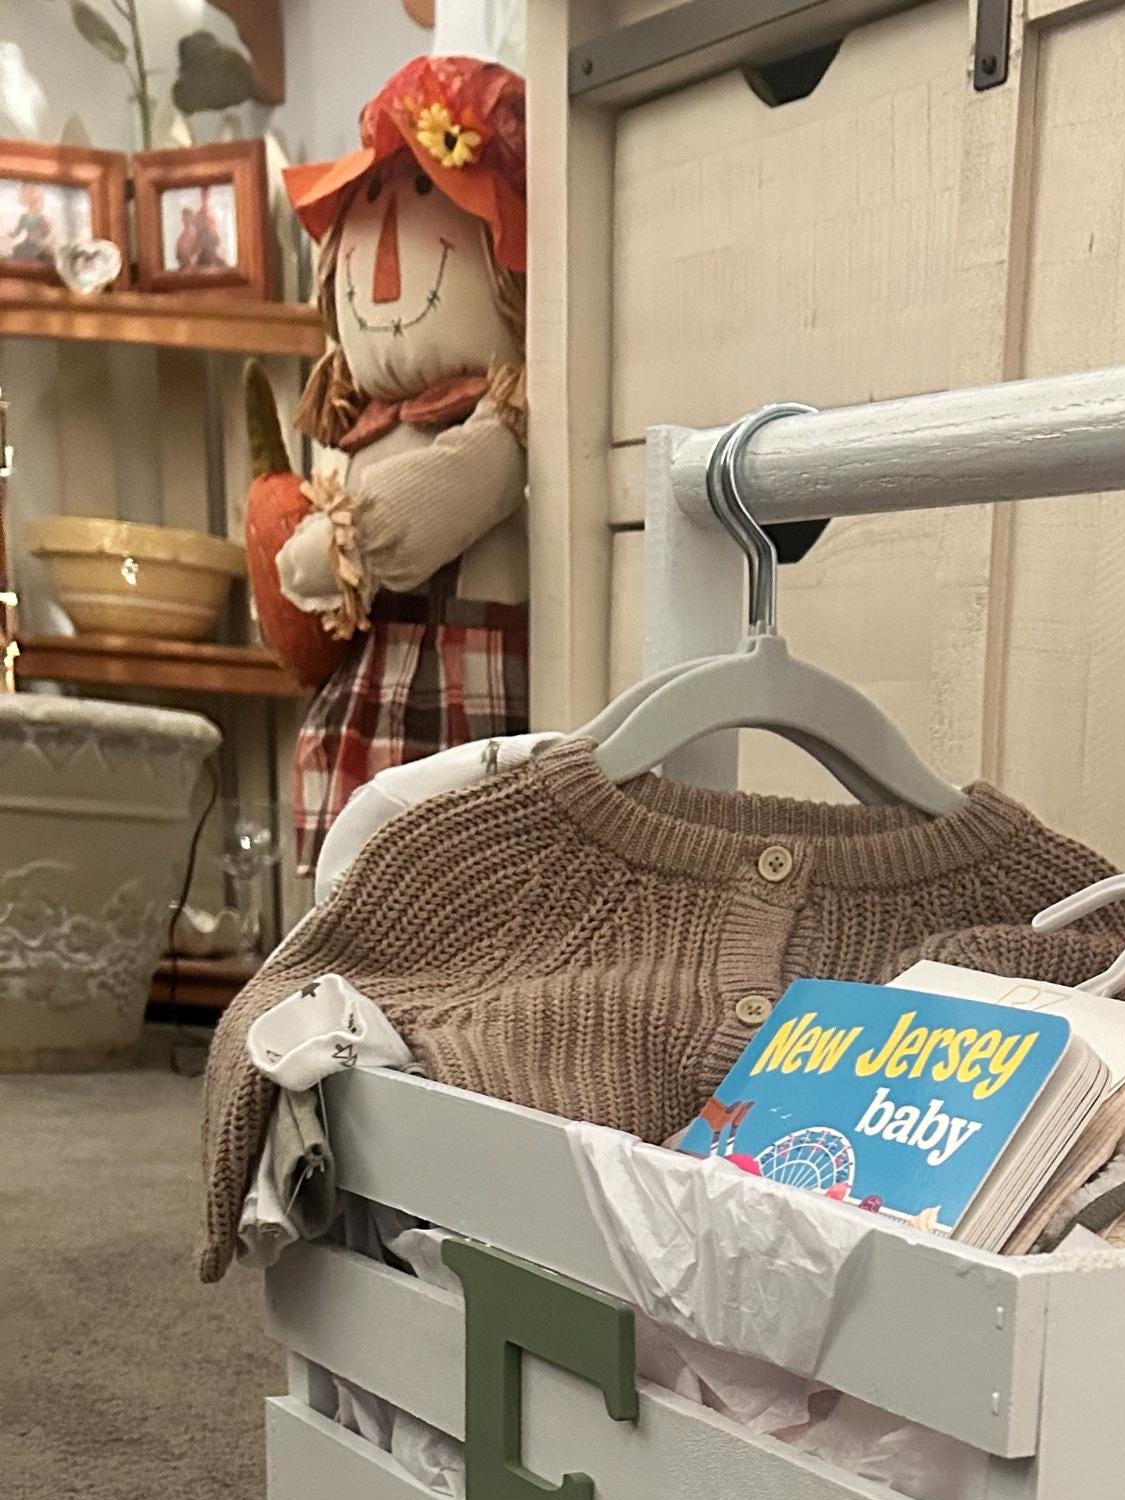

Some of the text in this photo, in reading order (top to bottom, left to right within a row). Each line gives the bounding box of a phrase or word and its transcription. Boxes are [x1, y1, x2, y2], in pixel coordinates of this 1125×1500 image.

[750, 1010, 1041, 1100] New Jersey
[854, 1088, 983, 1166] baby
